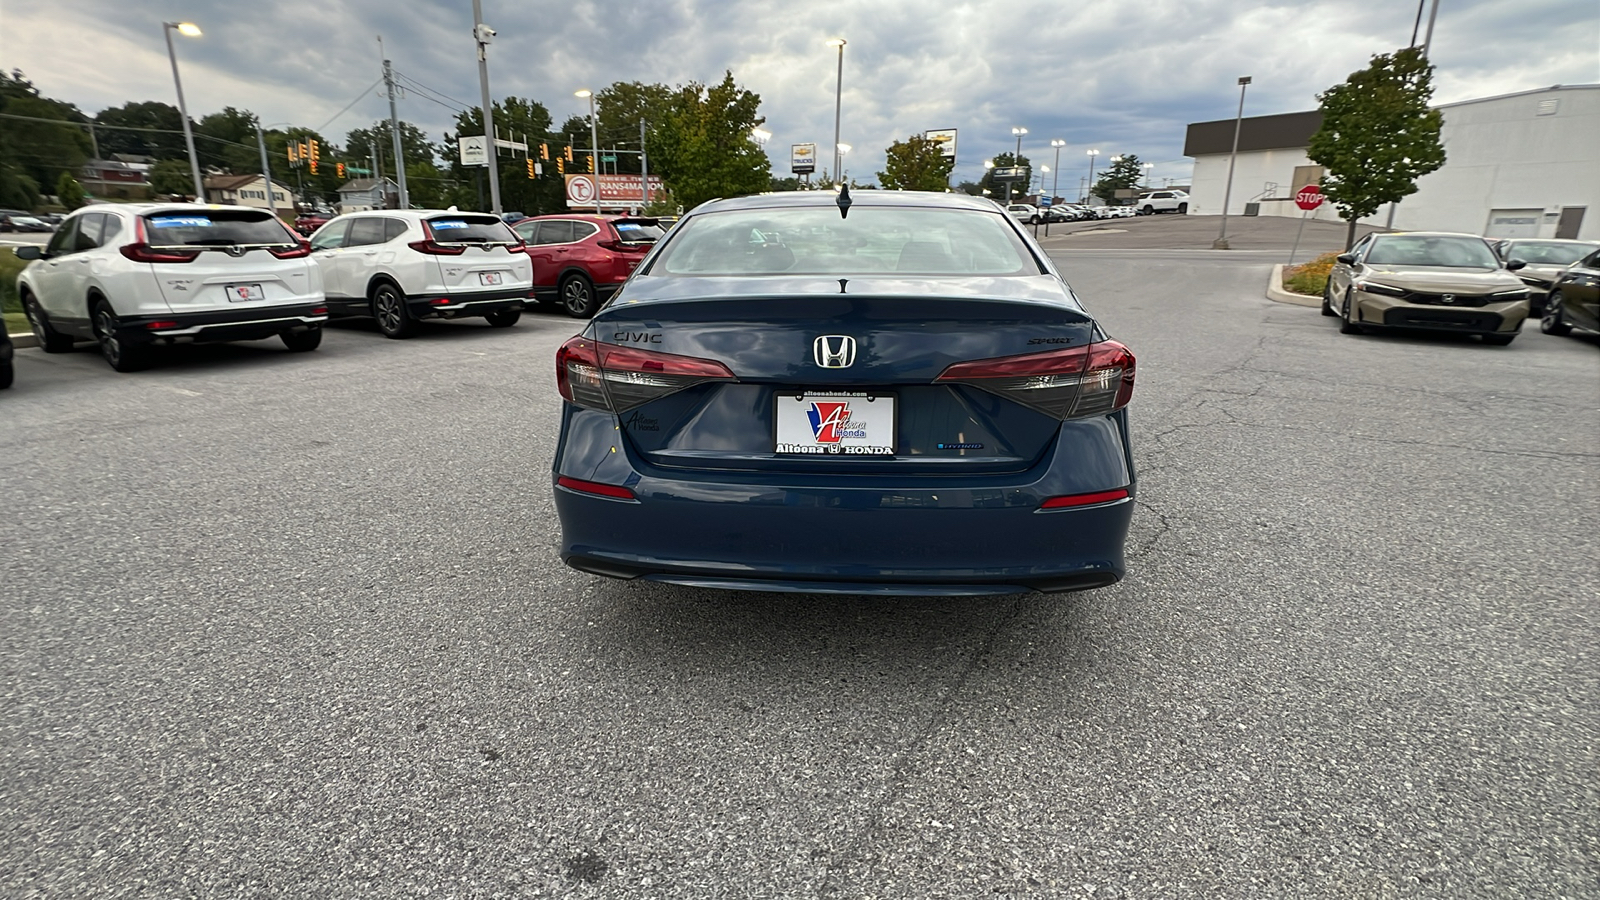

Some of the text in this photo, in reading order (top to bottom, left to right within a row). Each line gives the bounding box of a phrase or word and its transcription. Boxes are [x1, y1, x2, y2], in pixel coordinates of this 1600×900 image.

[598, 182, 664, 191] RANS4MAION
[1296, 192, 1324, 203] STOP
[614, 332, 662, 344] CIVIC
[1026, 336, 1075, 345] SPORT
[638, 424, 660, 432] Honda
[836, 429, 866, 438] Honda
[776, 444, 894, 455] Altoona HONDA
